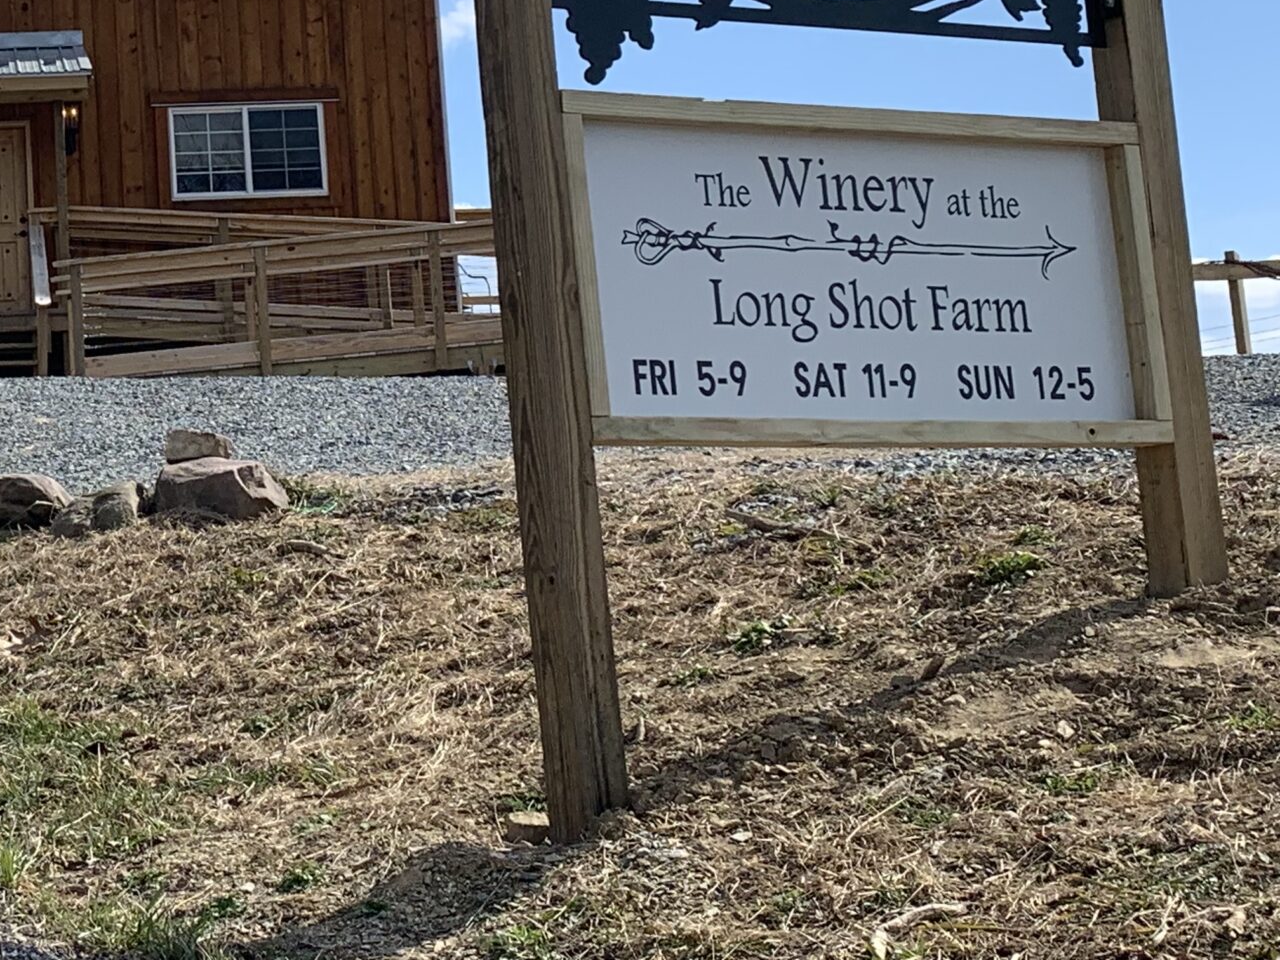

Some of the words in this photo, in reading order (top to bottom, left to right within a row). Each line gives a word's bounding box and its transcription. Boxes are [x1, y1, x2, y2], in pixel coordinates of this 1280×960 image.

[694, 171, 752, 208] The
[757, 155, 935, 229] Winery
[946, 188, 972, 217] at
[978, 184, 1021, 219] the
[708, 278, 818, 343] Long
[828, 278, 918, 332] Shot
[926, 285, 1033, 333] Farm
[632, 358, 678, 396] FRI
[696, 360, 747, 397] 5-9
[793, 361, 847, 398] SAT
[861, 363, 917, 399] 11-9
[957, 364, 1016, 401] SUN
[1032, 365, 1095, 402] 12-5
